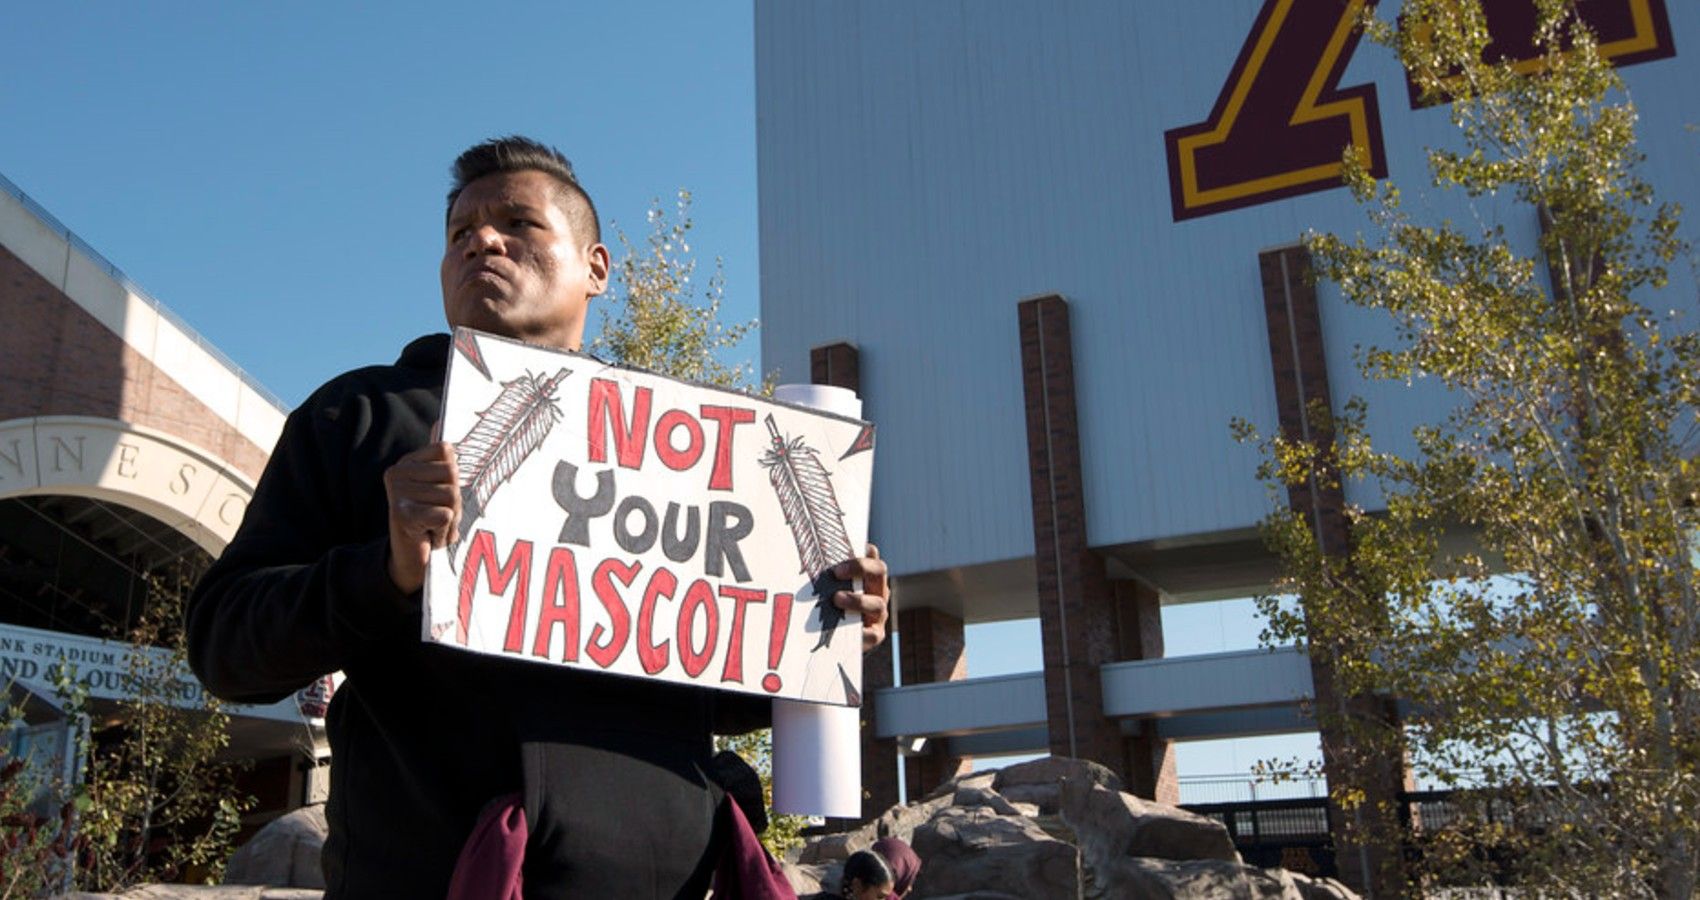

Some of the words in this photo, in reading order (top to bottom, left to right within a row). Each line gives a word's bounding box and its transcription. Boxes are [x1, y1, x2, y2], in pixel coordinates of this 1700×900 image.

[588, 377, 756, 491] NOT
[551, 459, 754, 582] YOUR
[33, 643, 115, 666] STADIUM
[456, 529, 794, 693] MASCOT!
